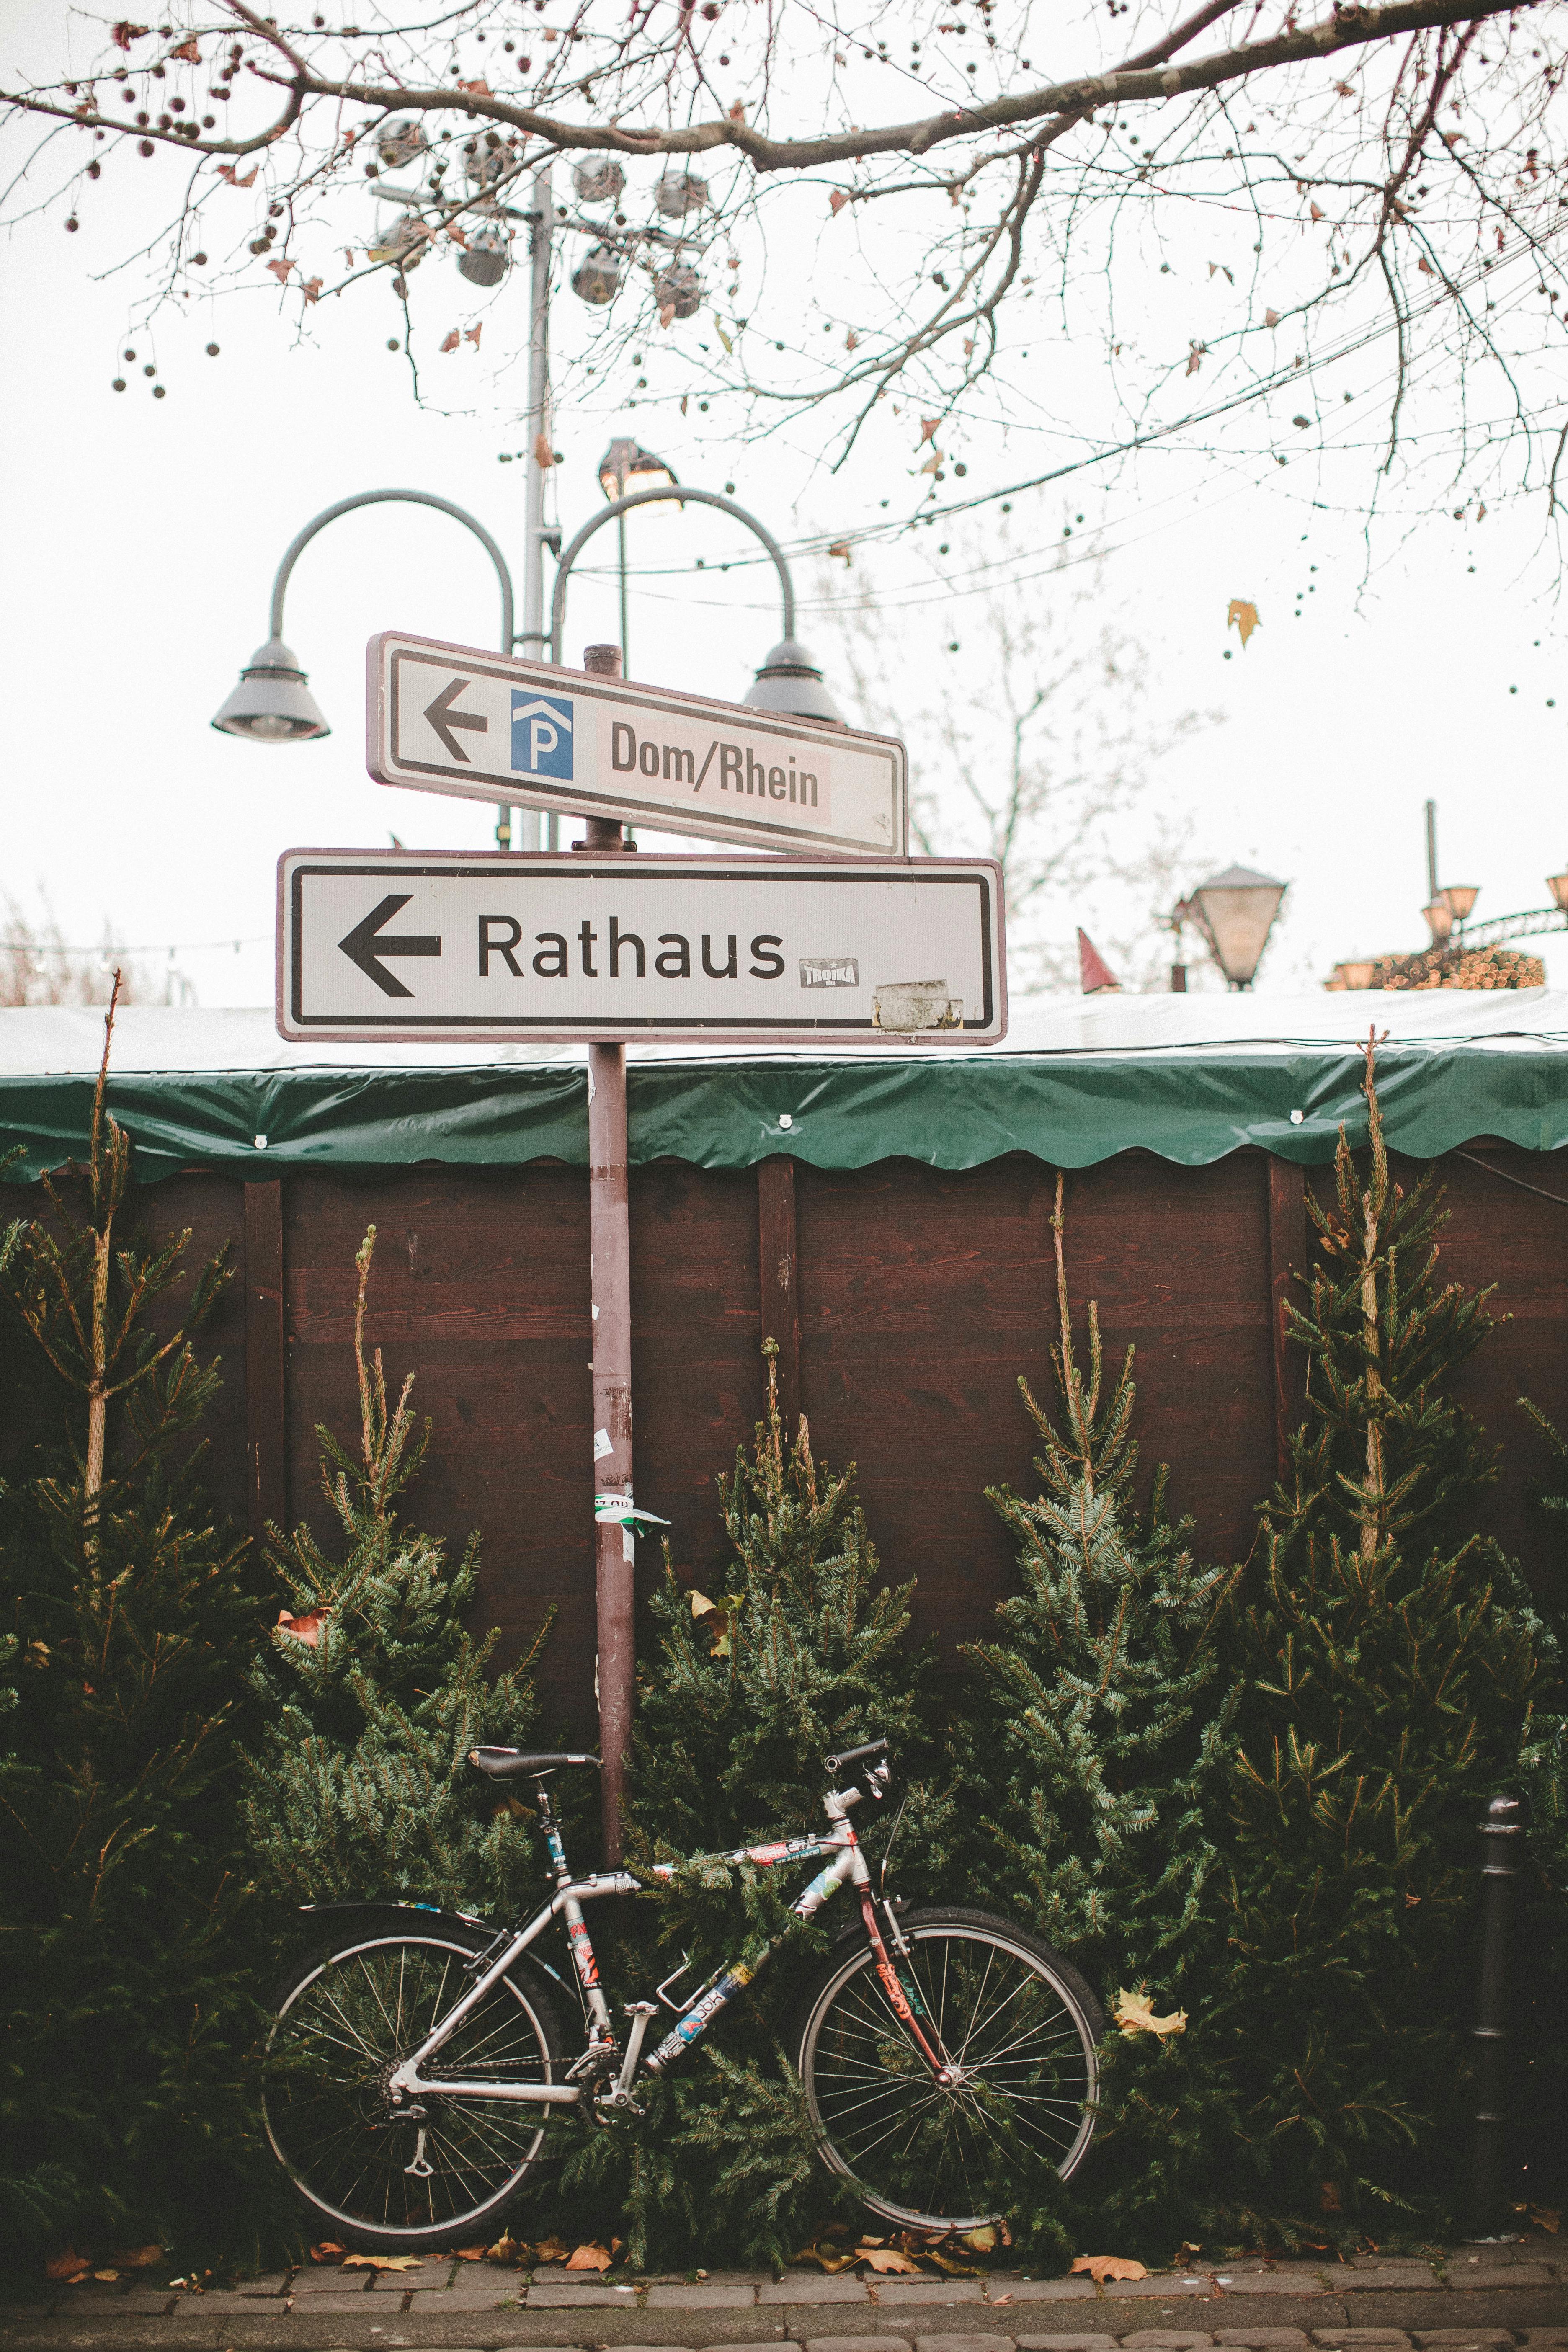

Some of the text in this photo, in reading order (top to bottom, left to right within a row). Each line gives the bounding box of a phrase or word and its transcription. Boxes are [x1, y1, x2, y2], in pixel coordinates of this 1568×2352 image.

[531, 719, 558, 770] P
[612, 721, 818, 807] Dom/Rhein
[478, 915, 785, 980] Rathaus
[804, 965, 856, 985] TROIKA
